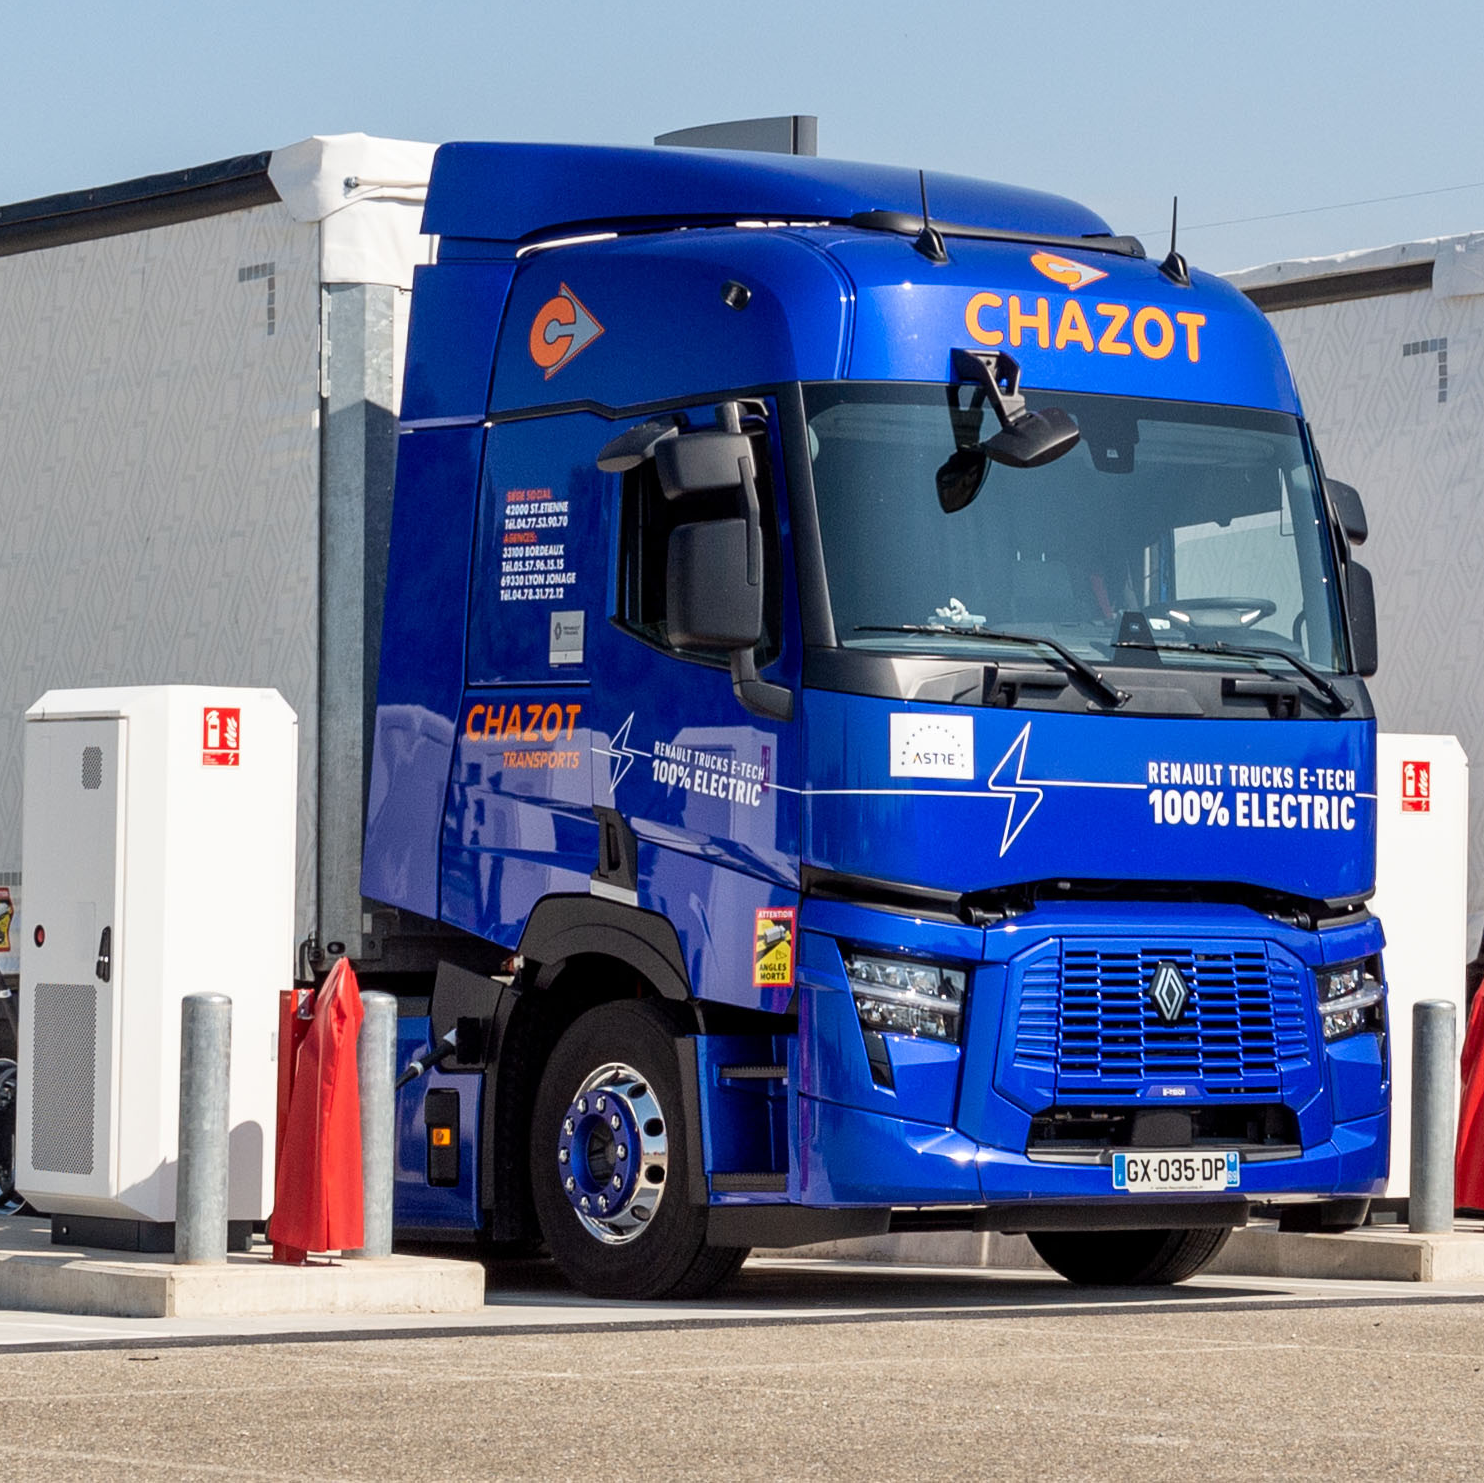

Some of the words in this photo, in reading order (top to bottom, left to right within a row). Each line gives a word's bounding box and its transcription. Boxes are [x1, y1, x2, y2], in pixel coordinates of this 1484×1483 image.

[965, 292, 1207, 363] CHAZOT
[525, 544, 564, 557] BORDEAUX
[525, 573, 545, 585] LYON
[546, 572, 577, 584] JONAGE
[466, 704, 581, 742] CHAZOT
[503, 751, 581, 769] TRANSPORTS
[654, 741, 692, 763] RENAULT
[694, 751, 729, 772] TRUCKS
[730, 761, 765, 781] E-TECH
[913, 752, 955, 765] ASTRE
[652, 759, 690, 788] 100%
[694, 770, 762, 807] ELECTRIC
[1148, 762, 1223, 786] RENAULT
[1229, 765, 1293, 789] TRUCKS
[1299, 768, 1355, 791] E-TECH
[1149, 789, 1229, 826] 100%
[1236, 792, 1355, 830] ELECTRIC
[759, 963, 787, 972] ANGLES
[760, 972, 786, 980] MORTS
